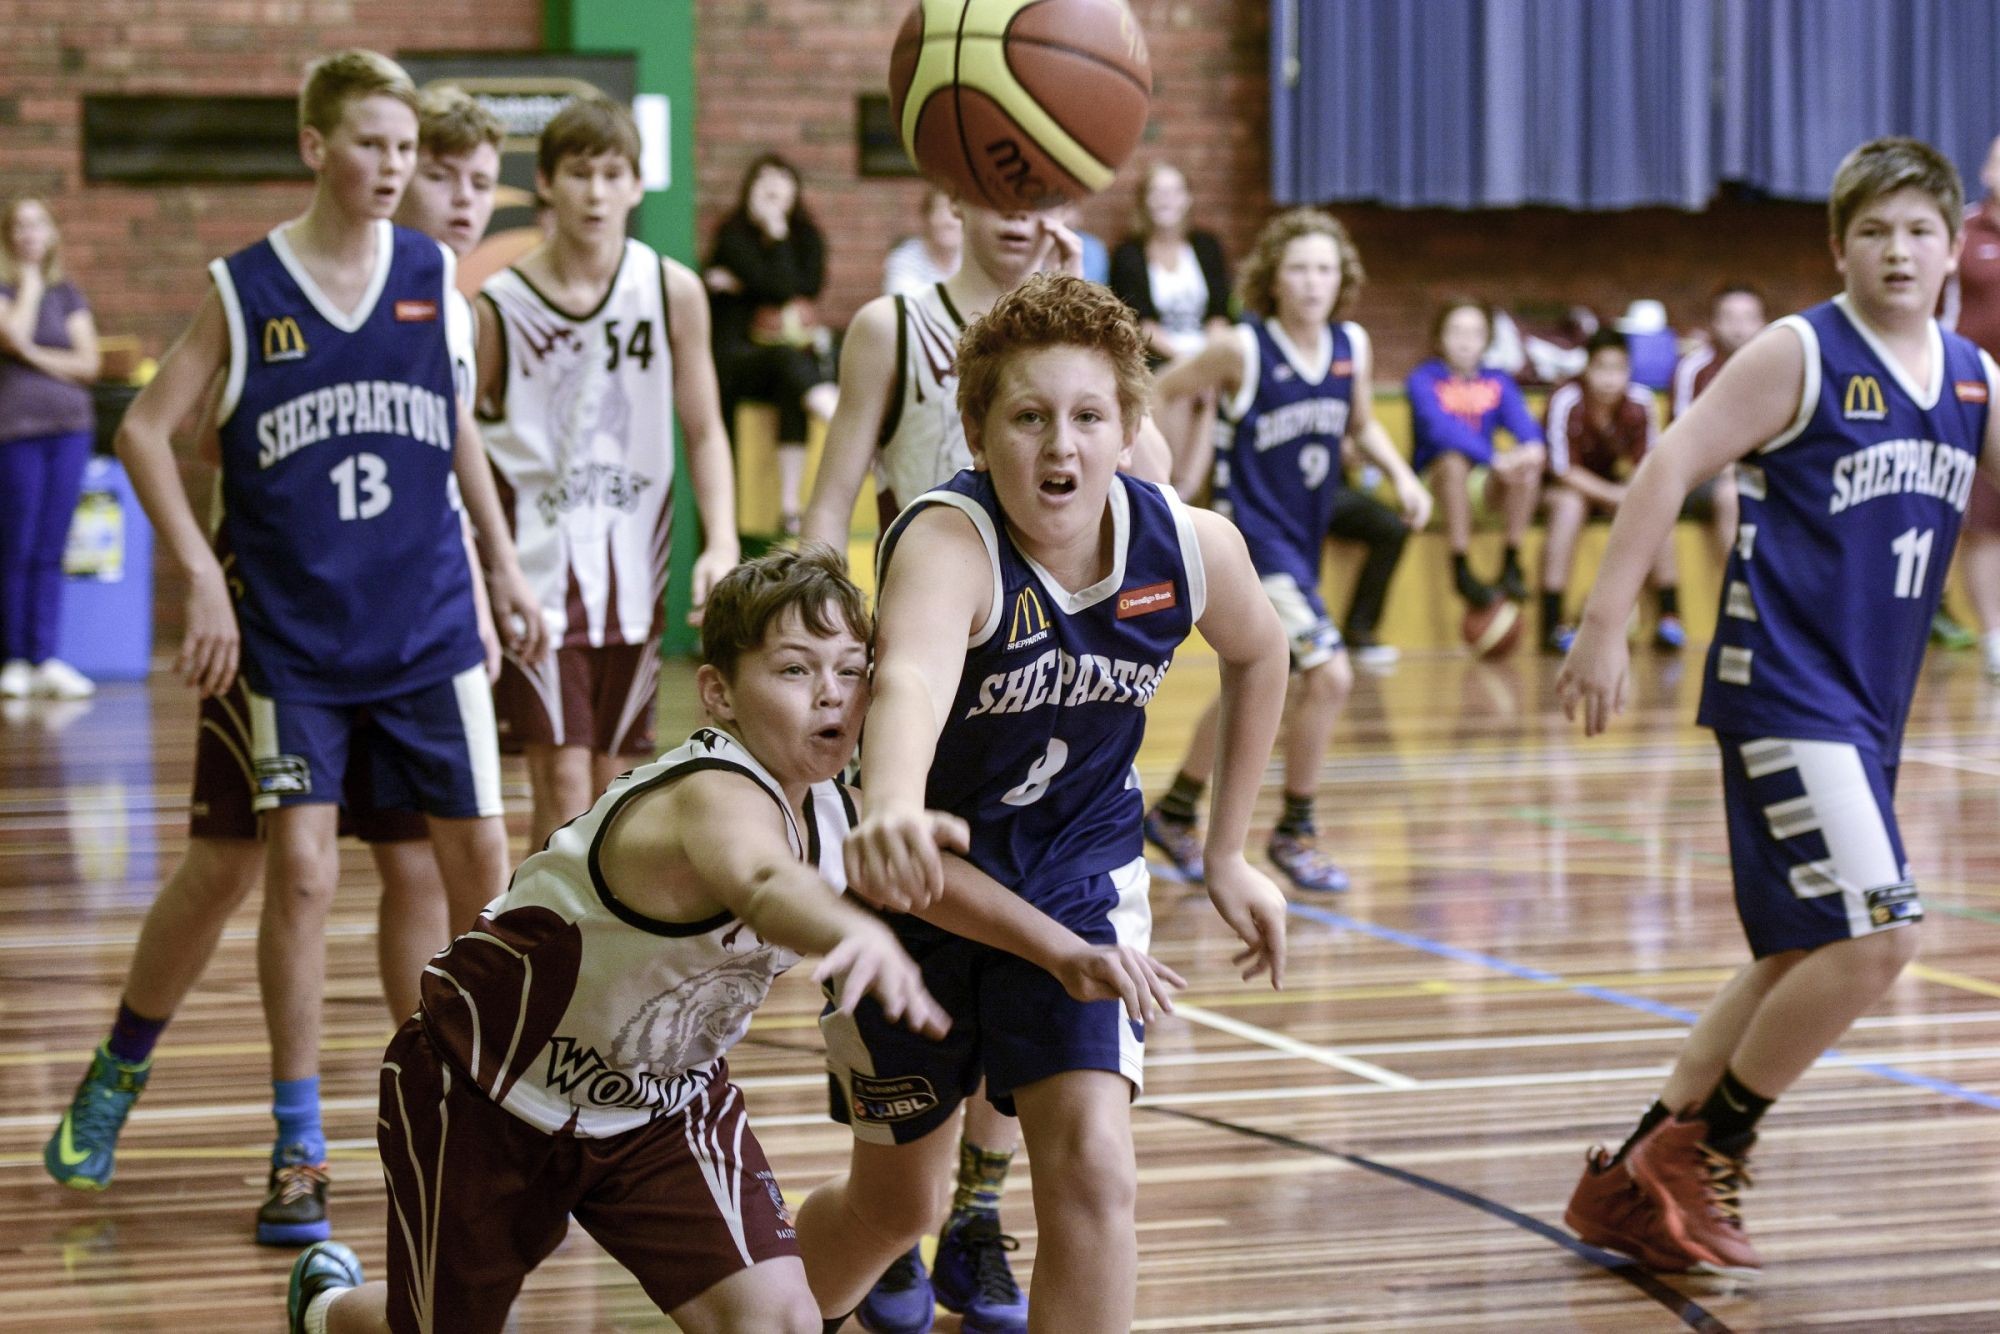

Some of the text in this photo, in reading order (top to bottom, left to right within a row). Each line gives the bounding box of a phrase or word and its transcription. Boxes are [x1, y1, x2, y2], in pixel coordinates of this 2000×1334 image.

[605, 321, 654, 372] 54
[257, 380, 450, 469] SHEPPARTON
[329, 452, 392, 521] 13
[1298, 443, 1330, 490] 9
[1891, 526, 1934, 599] 11
[1007, 630, 1048, 650] SHEPPARTON
[965, 648, 1170, 720] SHEPARTO
